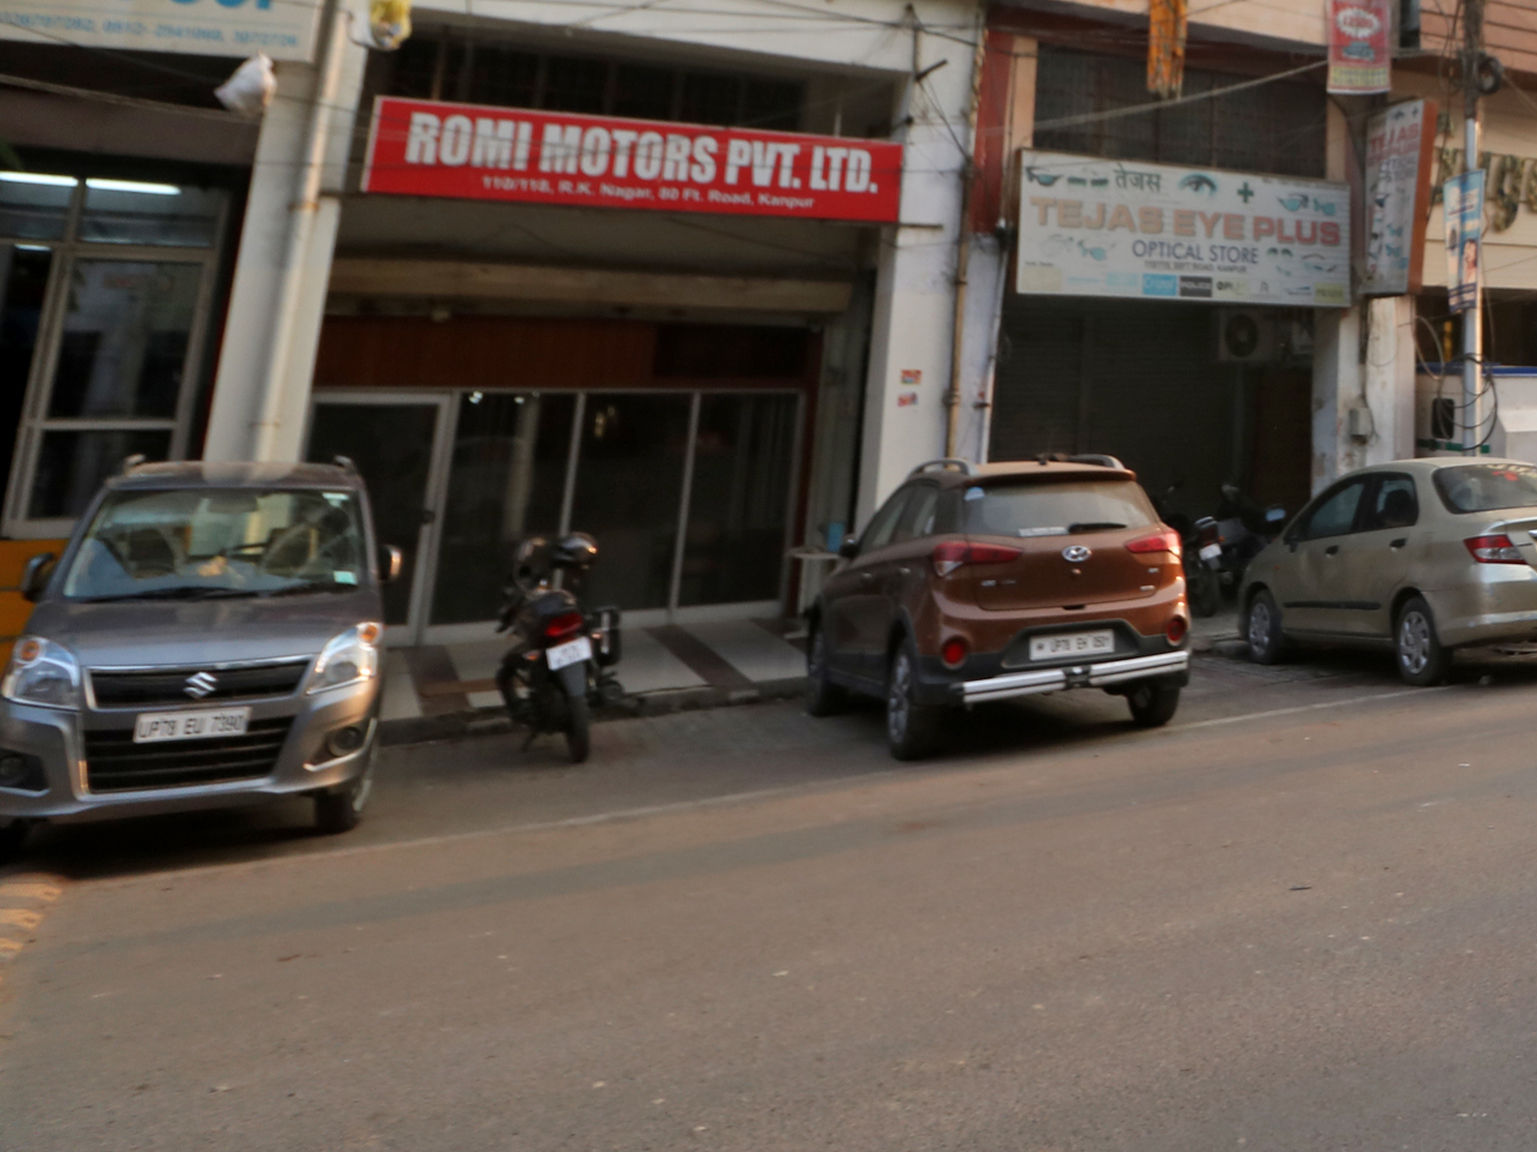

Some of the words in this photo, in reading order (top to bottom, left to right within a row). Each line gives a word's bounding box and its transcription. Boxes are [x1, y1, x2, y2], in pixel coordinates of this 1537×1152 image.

[405, 111, 533, 170] ROMI
[538, 123, 718, 184] MOTORS
[725, 138, 801, 189] PVT.
[809, 145, 878, 194] LTD.
[1114, 163, 1162, 193] तेजस
[1030, 196, 1164, 236] TEJAS
[1173, 209, 1245, 241] EYE
[1252, 215, 1340, 246] PLUS
[1132, 240, 1204, 262] OPTICAL
[1208, 244, 1259, 265] STORE
[139, 720, 176, 738] UP78
